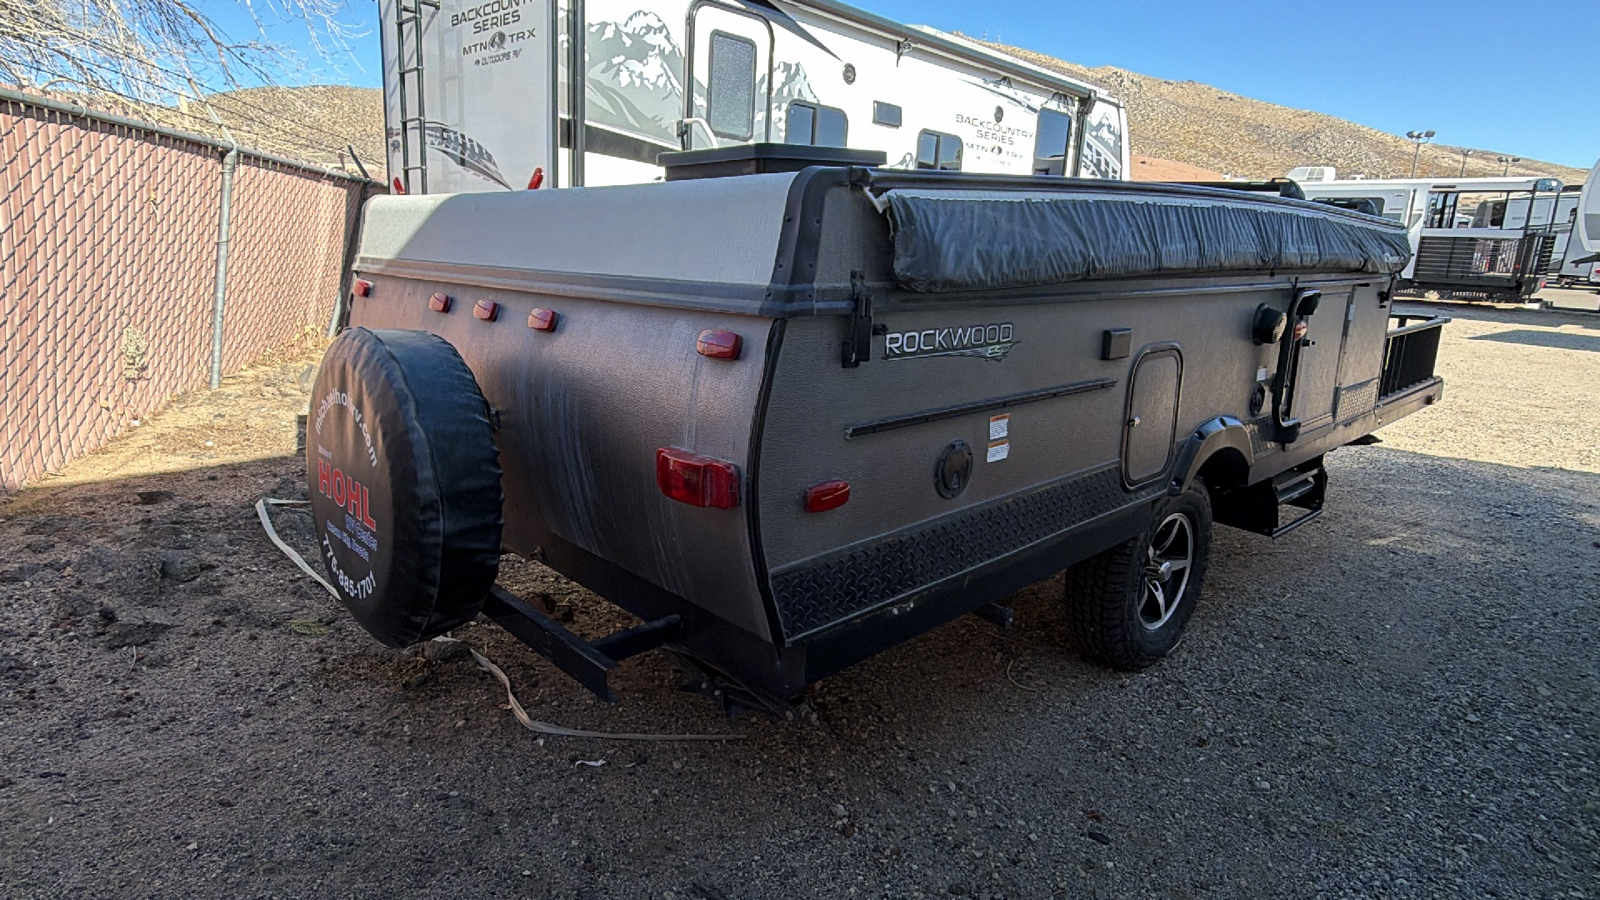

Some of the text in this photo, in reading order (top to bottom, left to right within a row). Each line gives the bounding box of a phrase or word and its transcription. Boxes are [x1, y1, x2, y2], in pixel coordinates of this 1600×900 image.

[451, 0, 533, 27] BACKCOUN
[473, 9, 521, 34] SERIES
[463, 28, 536, 55] MTN TRX
[955, 113, 1034, 139] BACKCOUNTRY
[976, 129, 1014, 146] SERIES
[965, 142, 988, 153] MTN
[885, 323, 1013, 355] ROCKWOOD
[317, 456, 377, 532] HOHL
